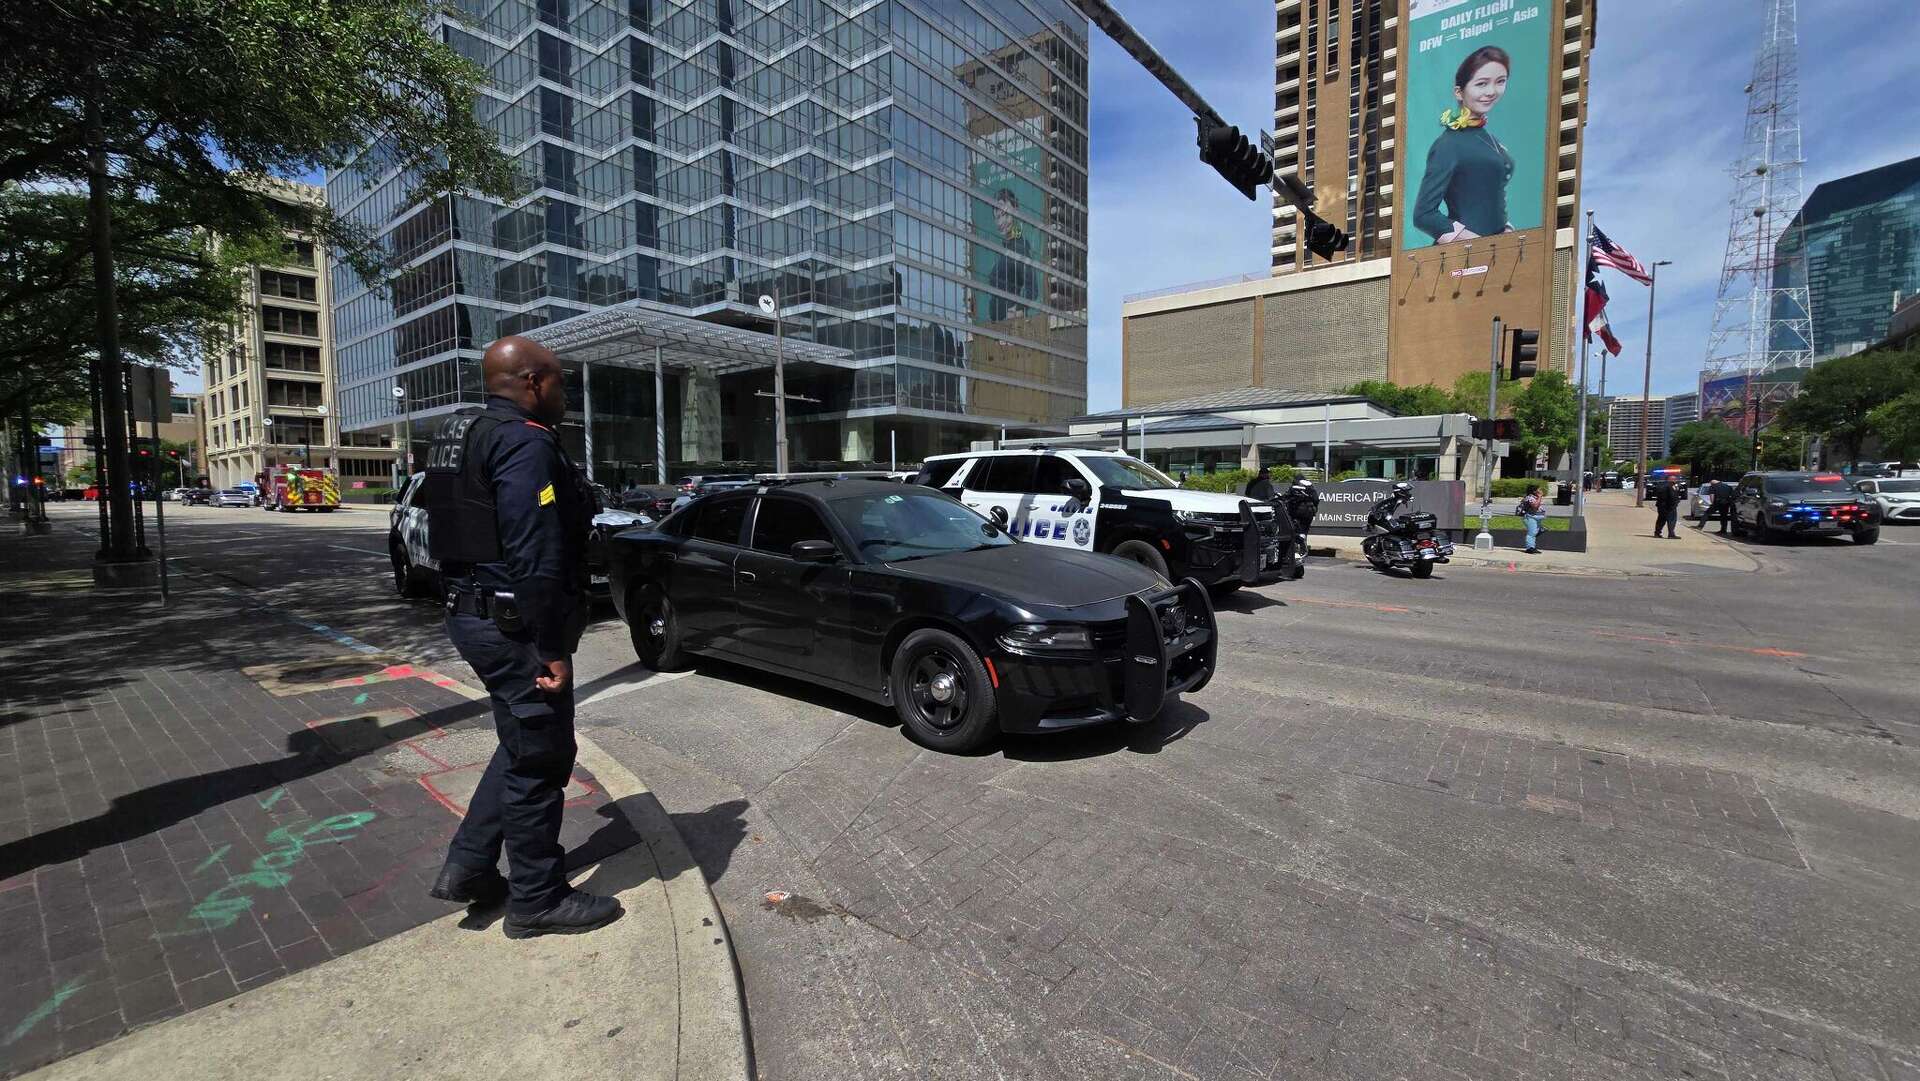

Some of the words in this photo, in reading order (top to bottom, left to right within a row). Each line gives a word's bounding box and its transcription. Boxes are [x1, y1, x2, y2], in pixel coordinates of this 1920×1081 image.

[1419, 35, 1443, 53] DFW
[1460, 20, 1493, 40] Taipei
[1513, 6, 1538, 24] Asia
[1441, 10, 1472, 31] DAILY
[1318, 491, 1371, 502] AMERICA
[1319, 513, 1342, 522] MAIN
[1344, 513, 1368, 523] STRE
[1009, 517, 1069, 541] LICE
